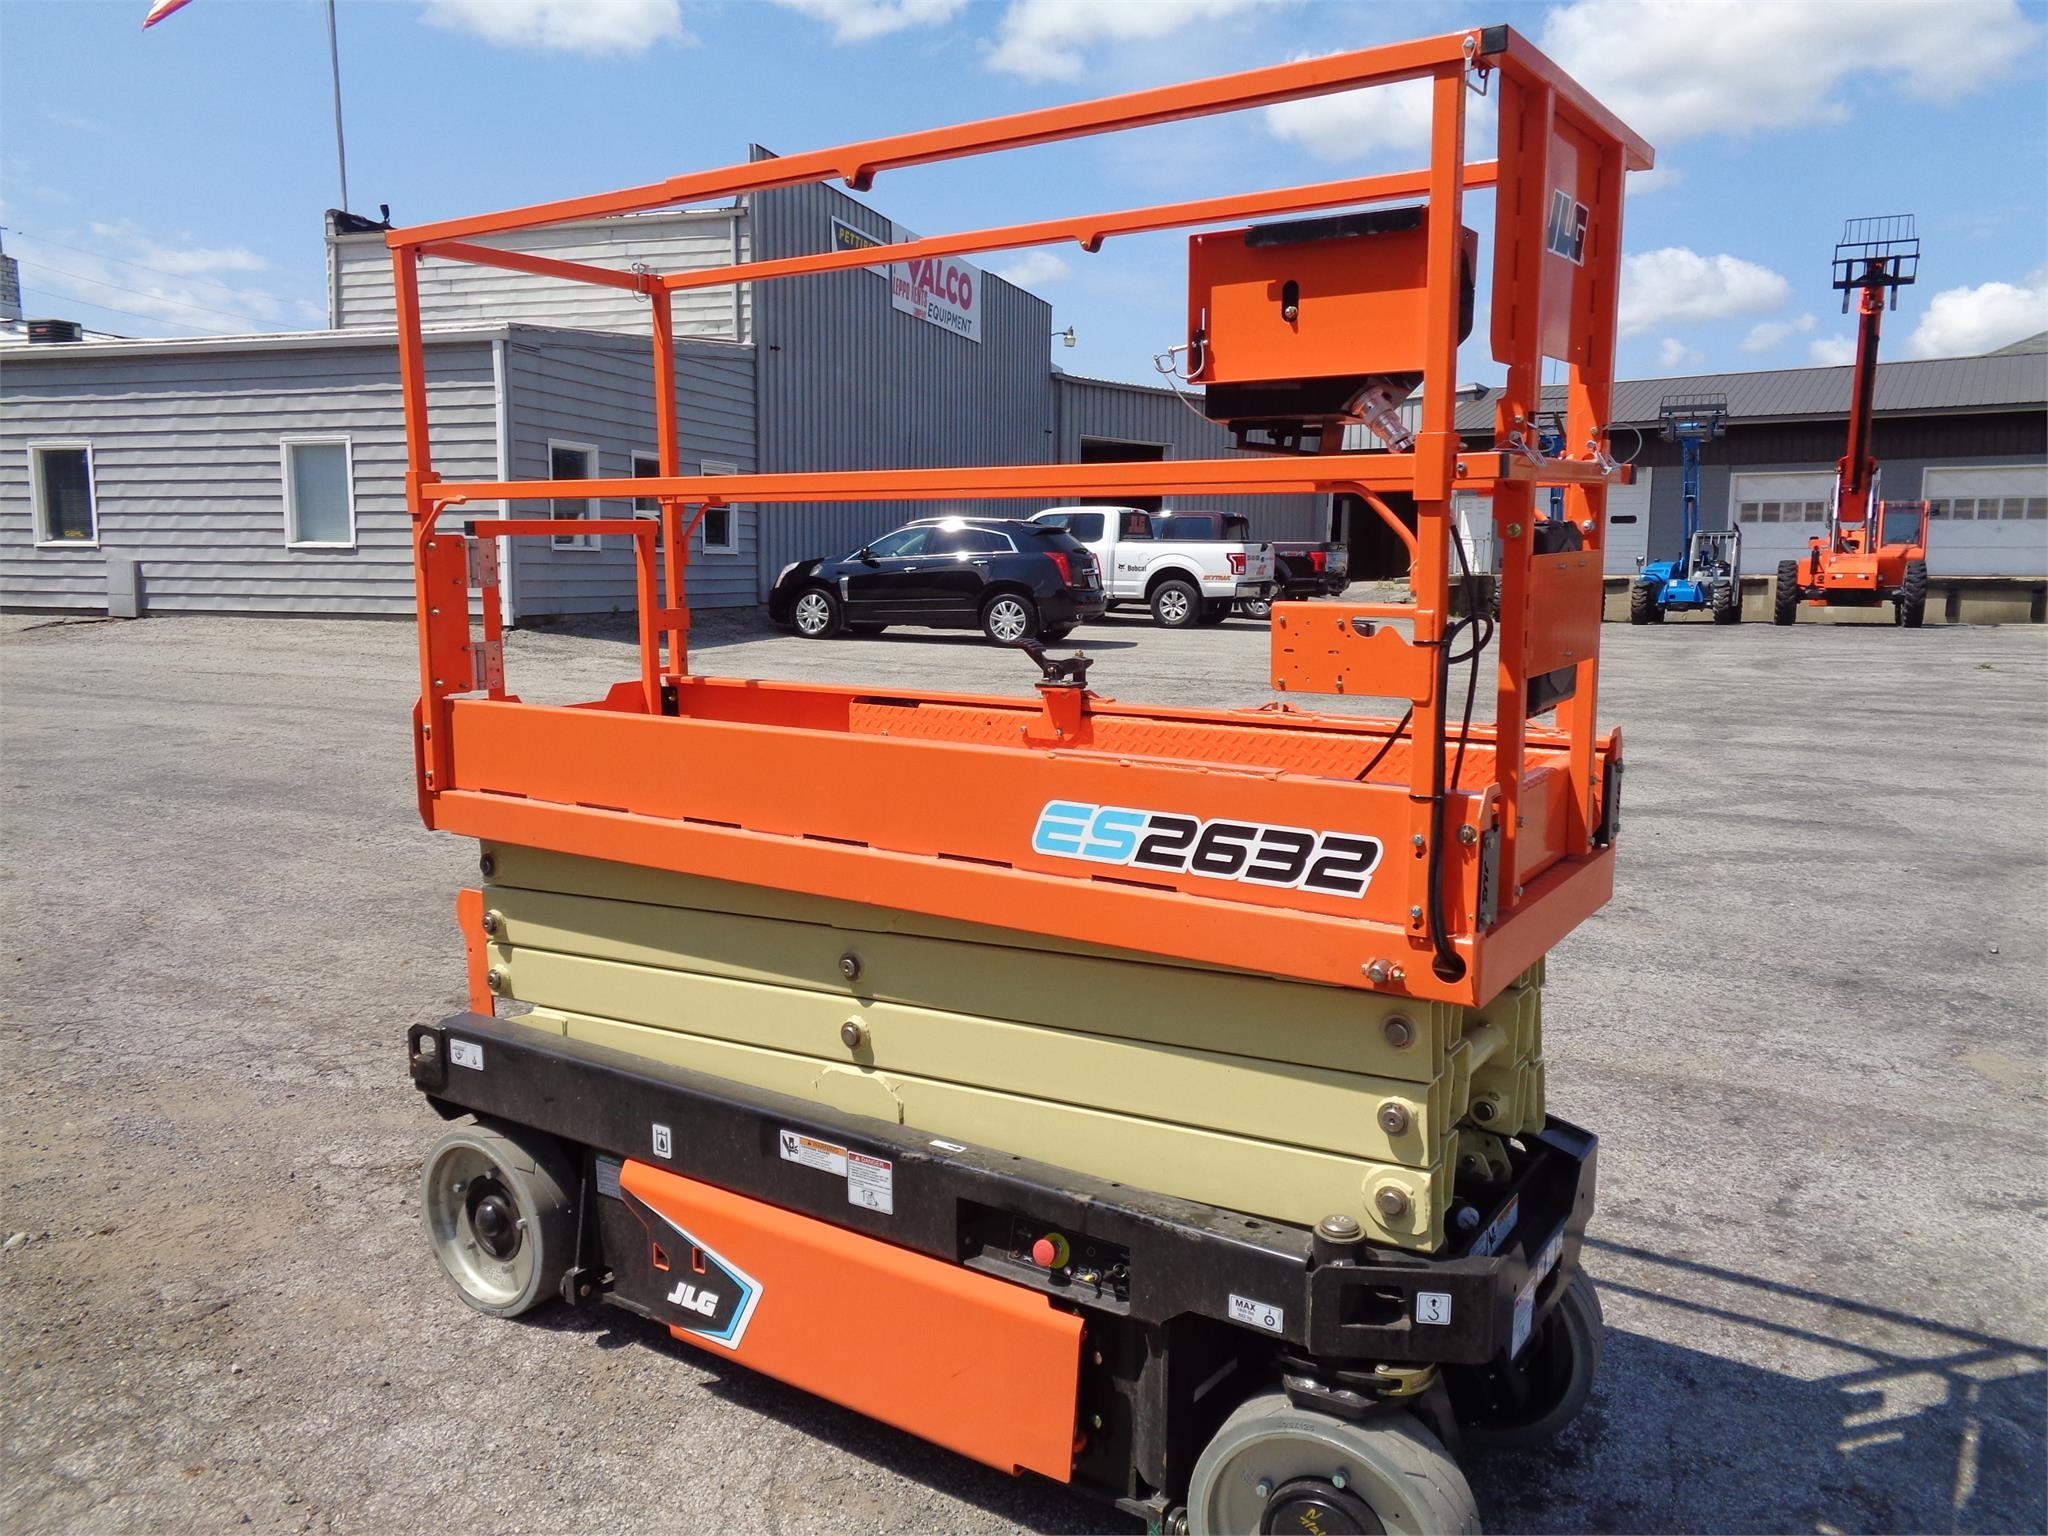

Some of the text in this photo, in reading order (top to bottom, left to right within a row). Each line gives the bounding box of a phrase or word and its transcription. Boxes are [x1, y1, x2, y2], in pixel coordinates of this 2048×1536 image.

[839, 227, 880, 249] PETTIB
[927, 302, 972, 334] EQUIPMENT
[1127, 564, 1147, 572] Bobcat
[1033, 801, 1382, 896] ES2632
[667, 1281, 720, 1318] JLG
[1235, 1299, 1256, 1312] MAX
